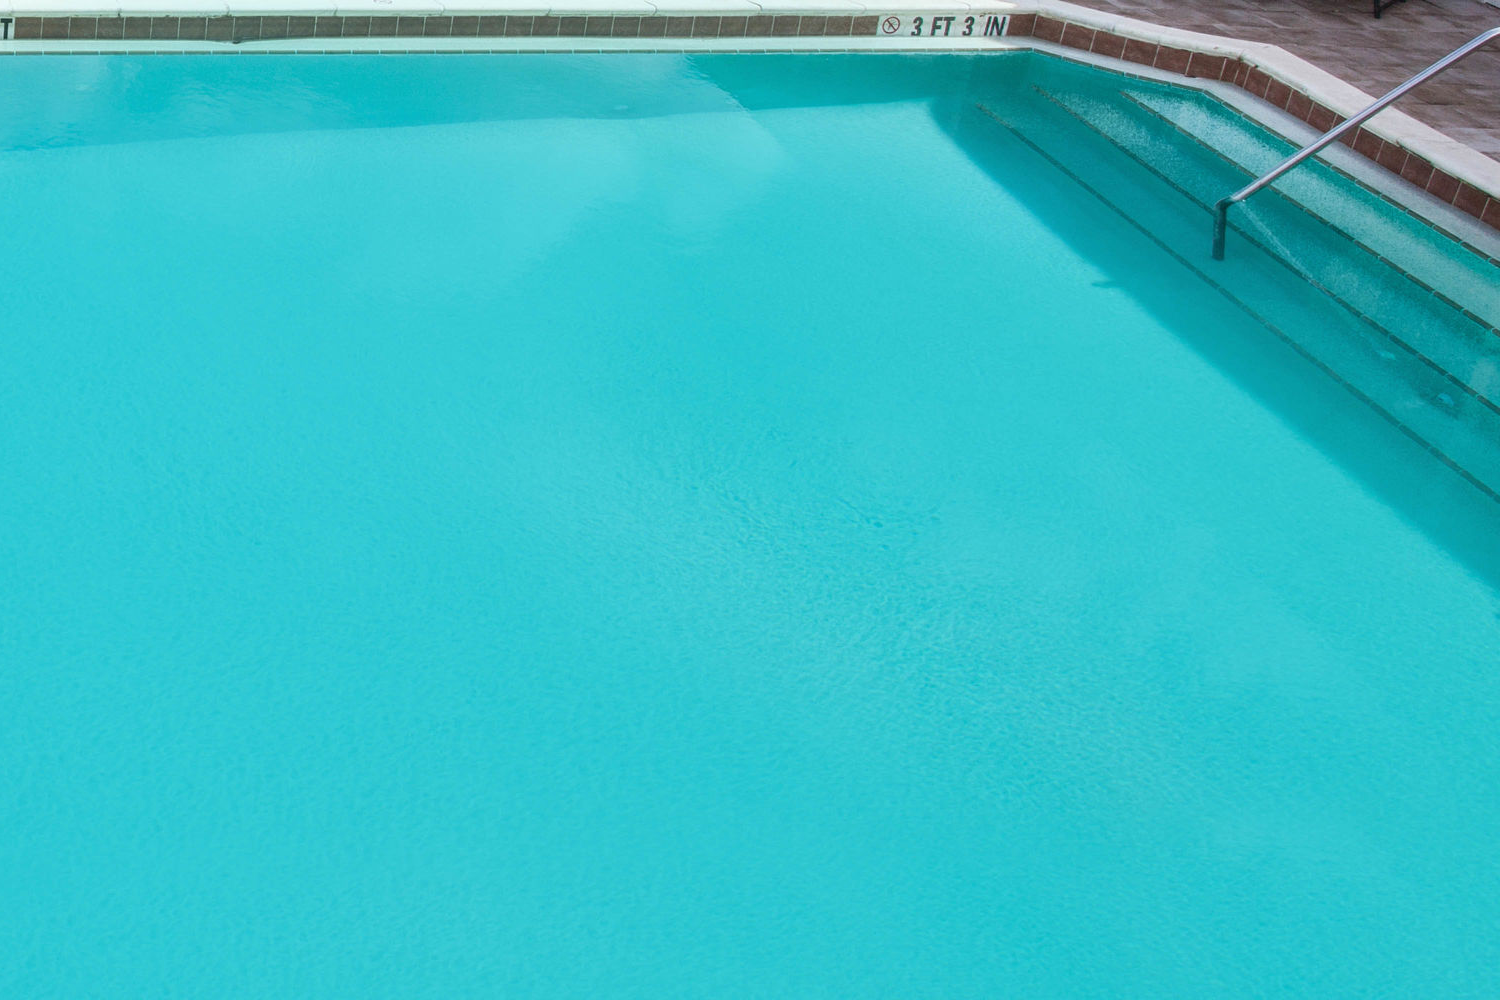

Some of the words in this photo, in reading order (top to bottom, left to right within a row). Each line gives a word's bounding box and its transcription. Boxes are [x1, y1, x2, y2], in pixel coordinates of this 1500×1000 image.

[910, 16, 924, 37] 3
[930, 16, 956, 37] FT
[962, 16, 975, 37] 3
[983, 16, 1007, 37] IN
